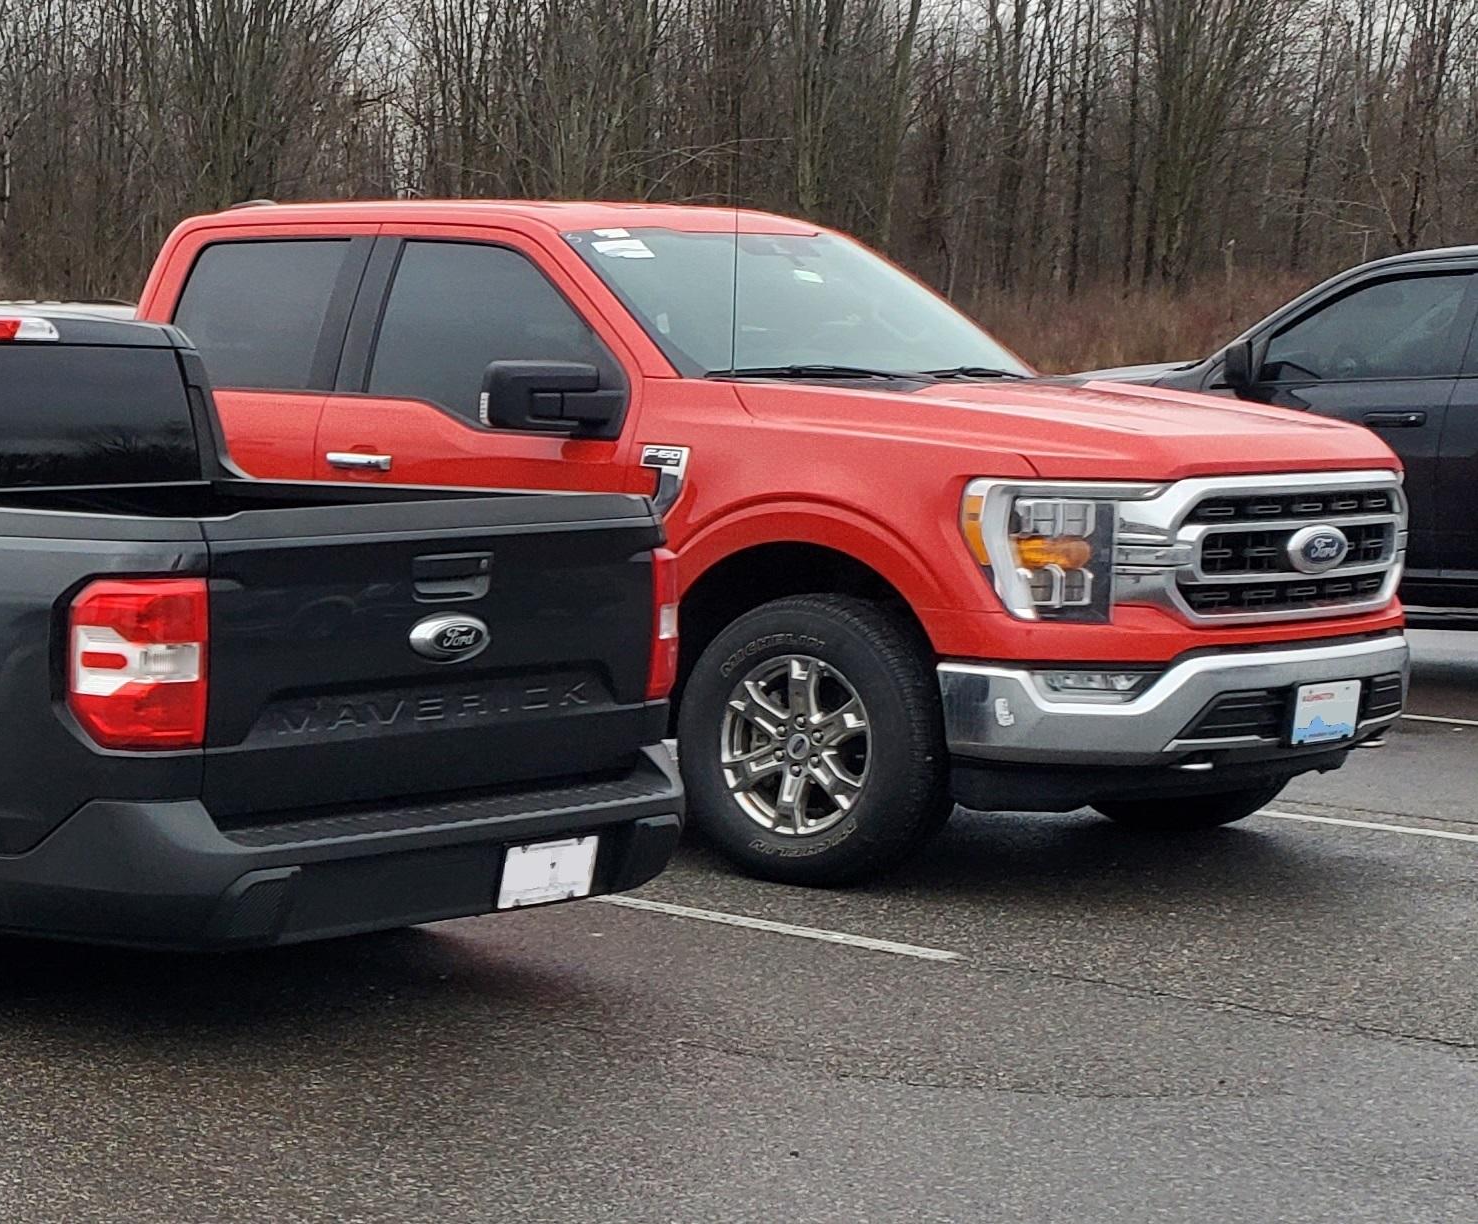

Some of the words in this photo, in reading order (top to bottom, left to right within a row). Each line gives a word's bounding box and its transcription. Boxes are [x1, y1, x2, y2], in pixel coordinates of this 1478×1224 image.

[1310, 537, 1339, 558] Ford
[442, 626, 476, 647] Ford
[720, 633, 826, 678] MICHELIN
[276, 681, 589, 735] MAVERICK
